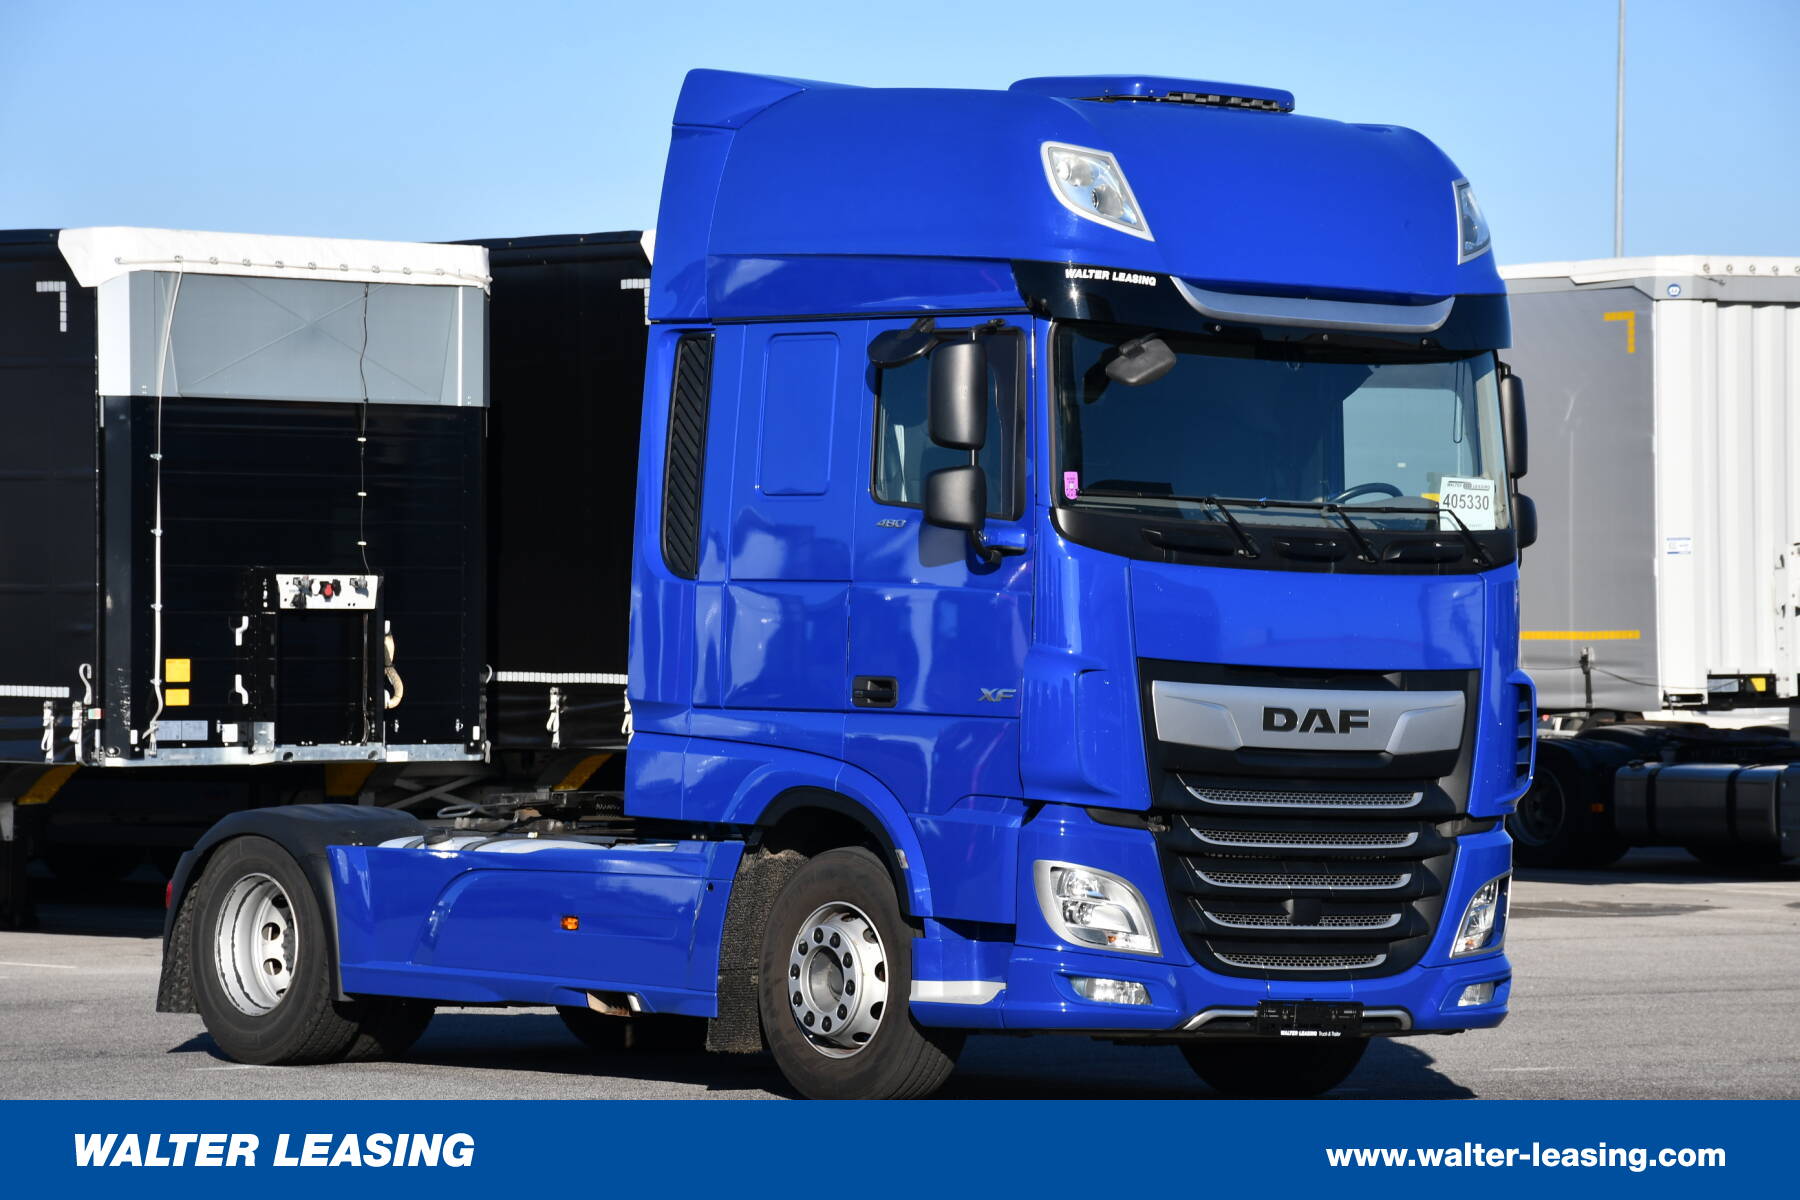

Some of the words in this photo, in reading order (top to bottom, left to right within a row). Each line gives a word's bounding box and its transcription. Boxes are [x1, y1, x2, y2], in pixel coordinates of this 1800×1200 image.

[1065, 268, 1110, 280] WALTER
[1112, 271, 1157, 286] LEASING
[1442, 493, 1490, 511] 405330
[876, 519, 907, 528] 480
[977, 687, 1017, 702] XF
[1262, 706, 1371, 734] DAF
